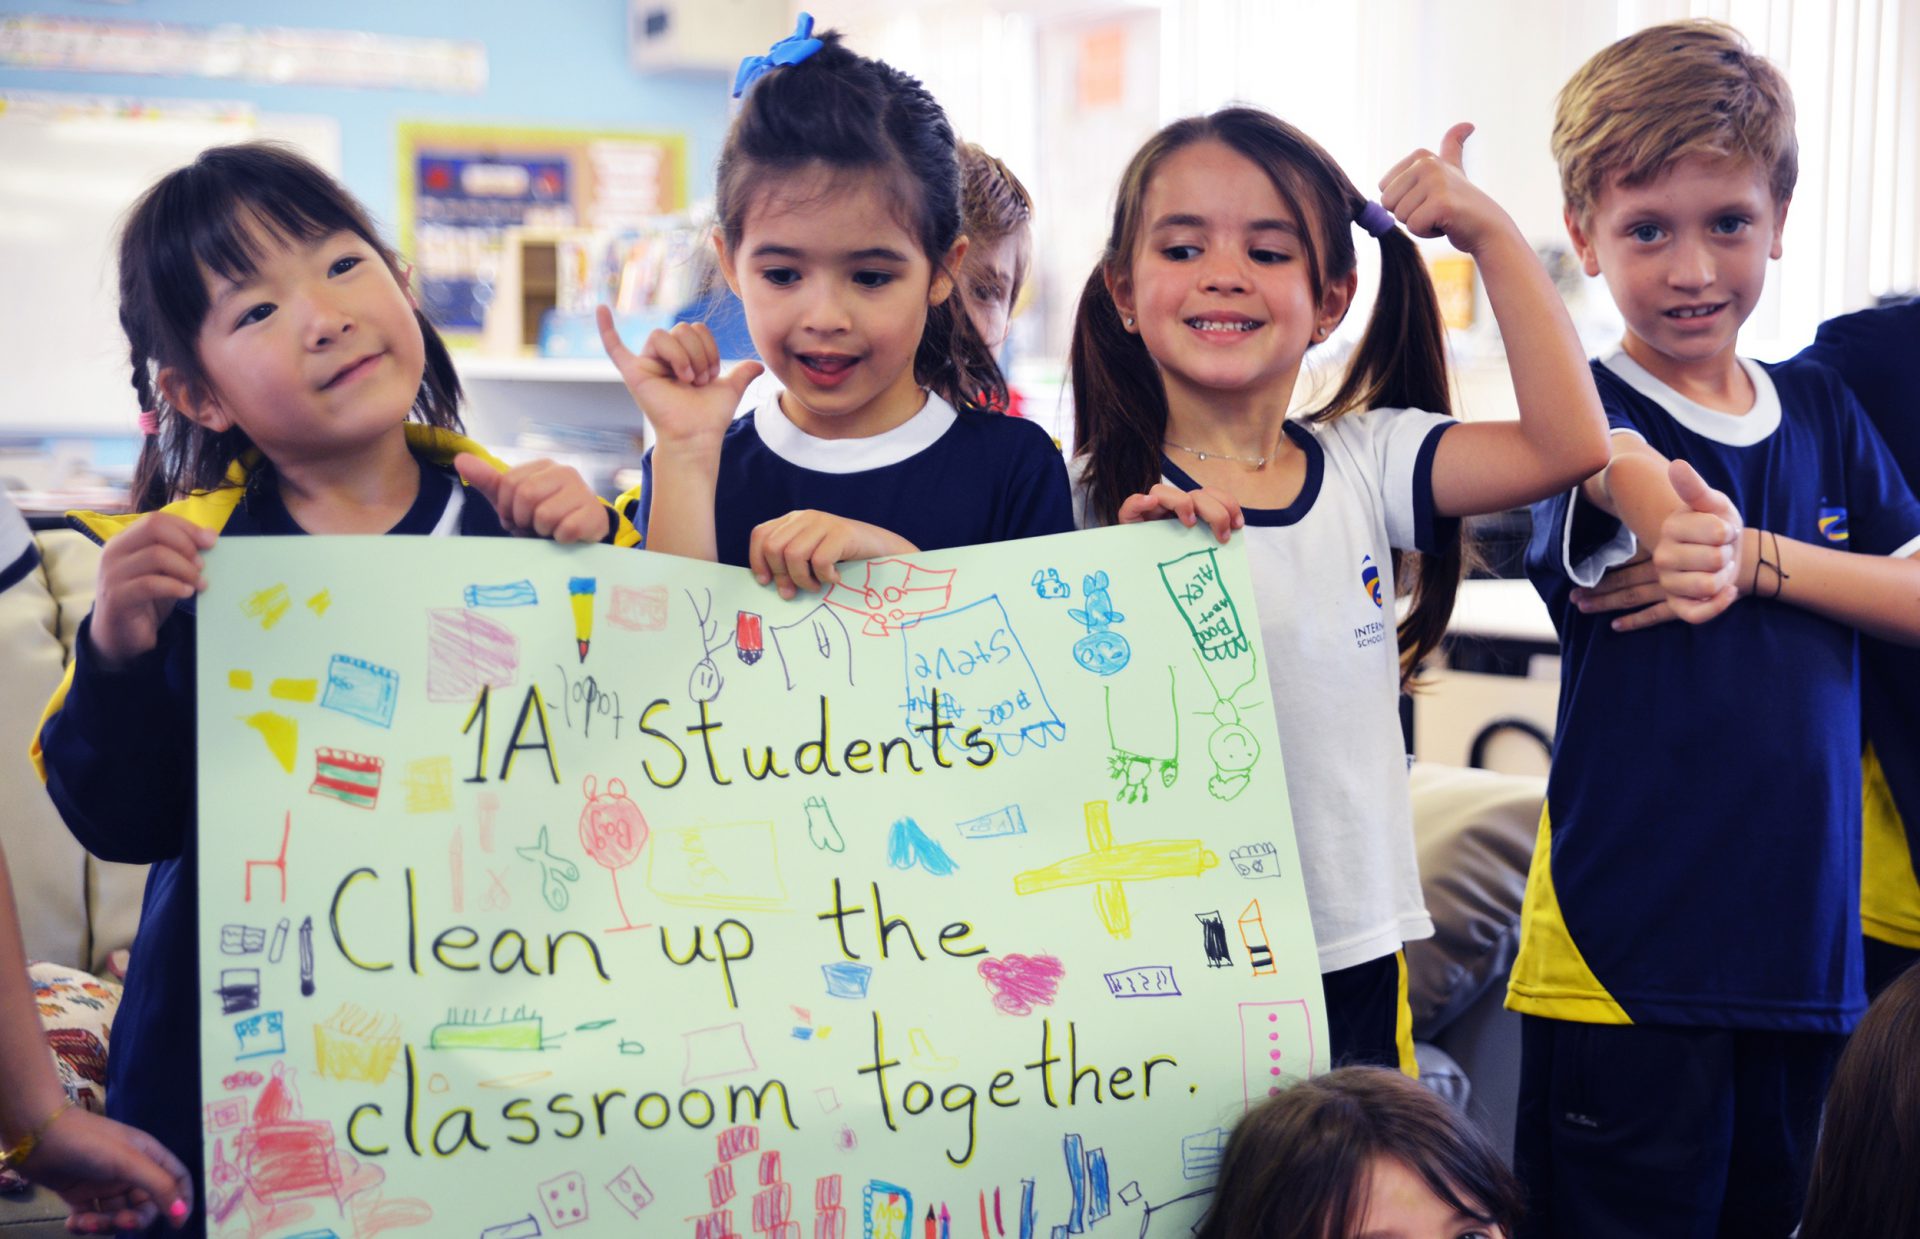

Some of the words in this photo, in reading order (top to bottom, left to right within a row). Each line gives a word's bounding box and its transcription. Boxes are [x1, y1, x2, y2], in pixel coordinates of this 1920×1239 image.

[460, 683, 561, 785] 1A
[637, 687, 996, 789] Students
[329, 866, 612, 985] Clean
[658, 916, 756, 1009] up
[816, 876, 989, 963] the
[346, 1043, 801, 1159] classroom
[856, 1010, 1199, 1168] together.
